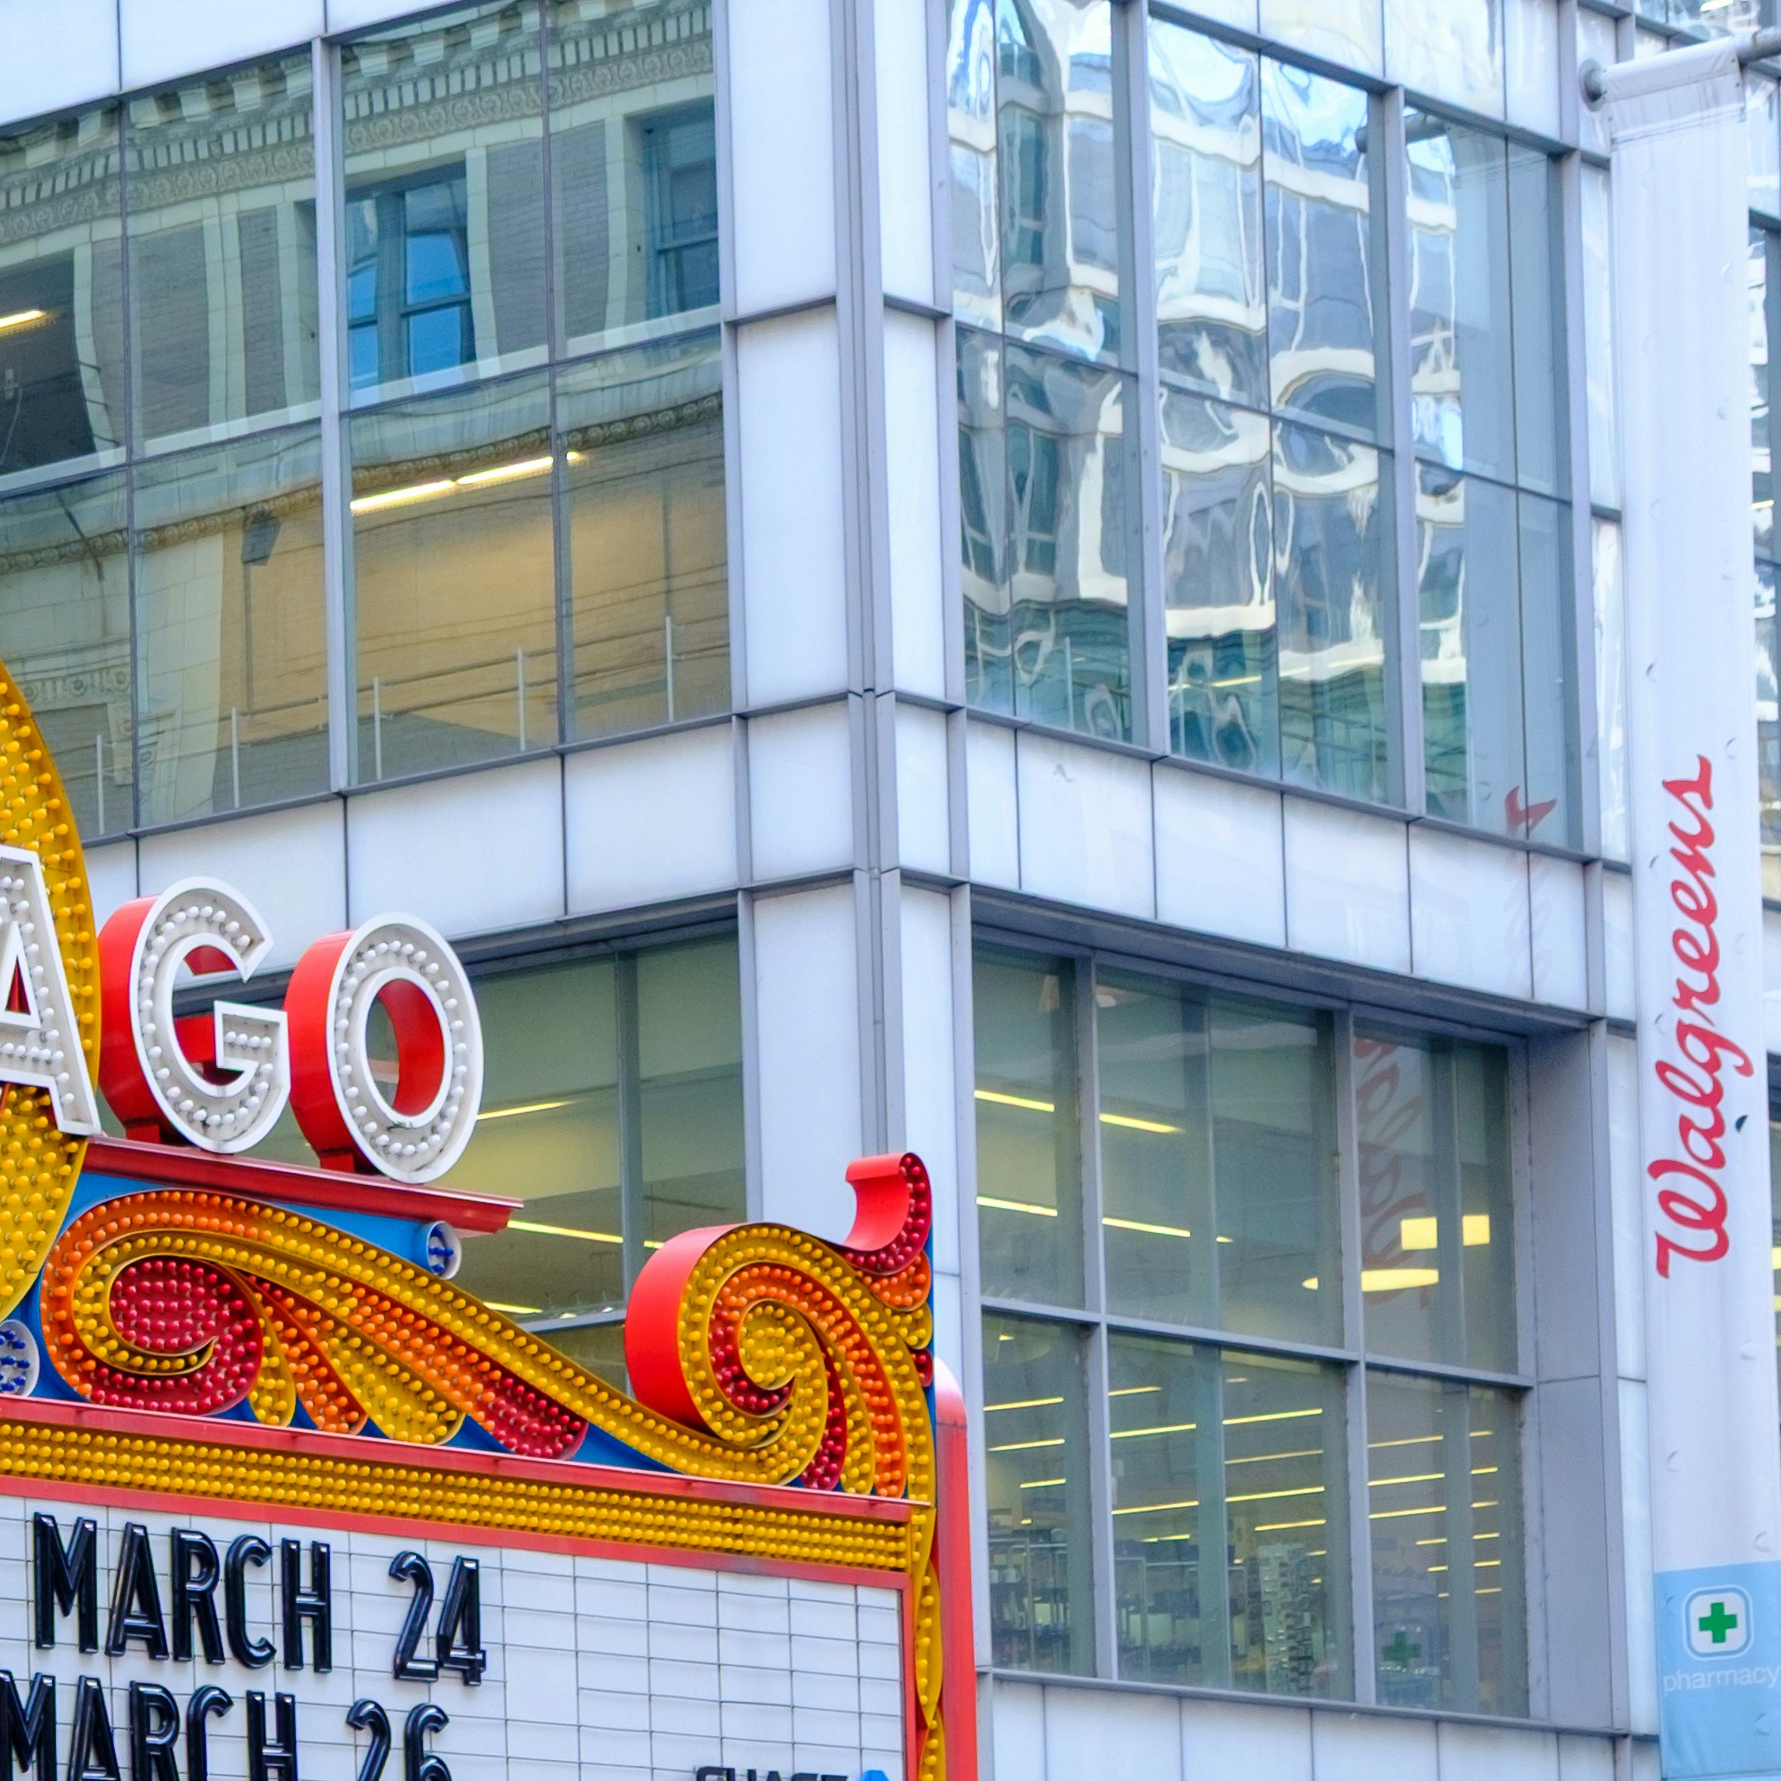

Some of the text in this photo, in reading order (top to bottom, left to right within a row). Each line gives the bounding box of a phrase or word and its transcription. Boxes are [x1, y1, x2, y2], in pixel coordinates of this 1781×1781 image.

[1656, 753, 1755, 1281] Walgreens
[35, 1511, 334, 1673] MARCH
[387, 1550, 489, 1688] 24
[1663, 1665, 1781, 1692] pharmacy
